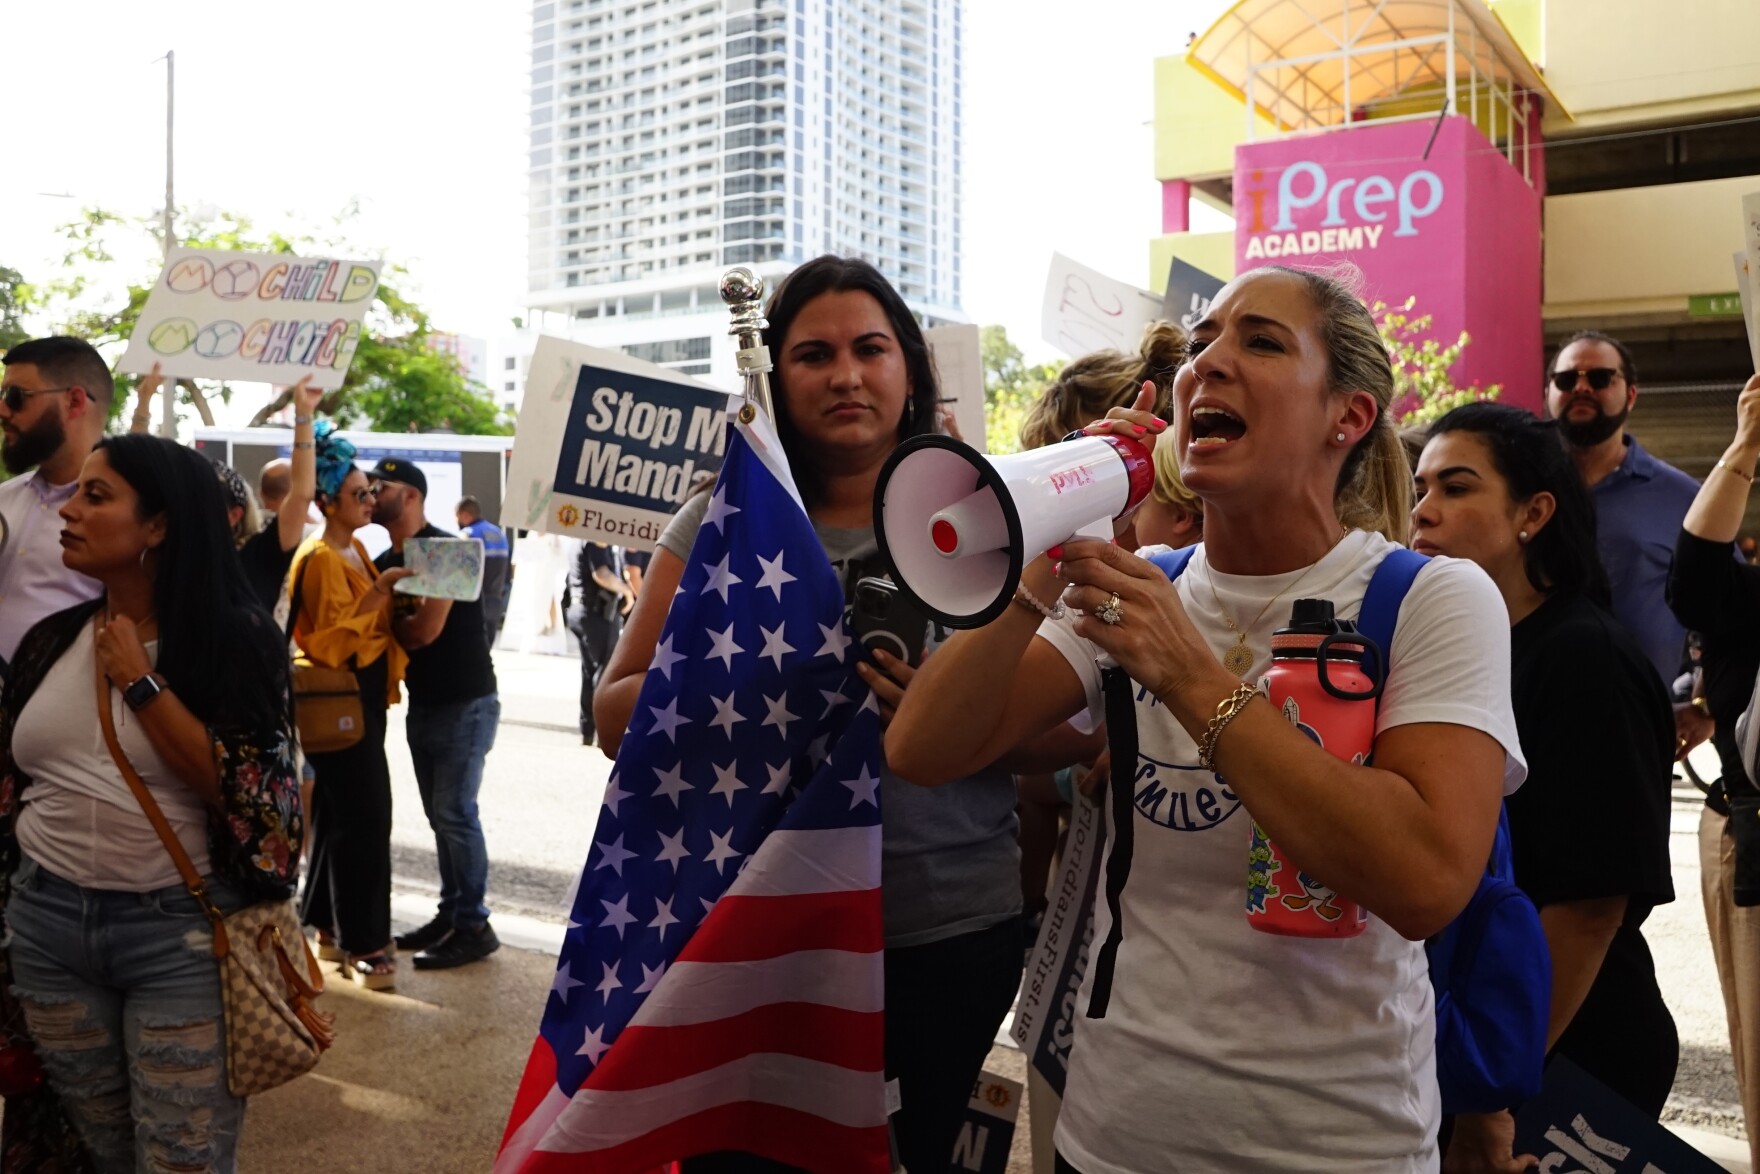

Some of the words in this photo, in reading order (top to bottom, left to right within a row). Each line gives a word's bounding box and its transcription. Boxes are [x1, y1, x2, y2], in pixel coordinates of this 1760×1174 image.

[1247, 160, 1444, 237] iPrep
[1244, 223, 1384, 260] ACADEMY
[167, 255, 260, 299] MY
[148, 316, 246, 359] MY
[585, 386, 682, 450] Stop
